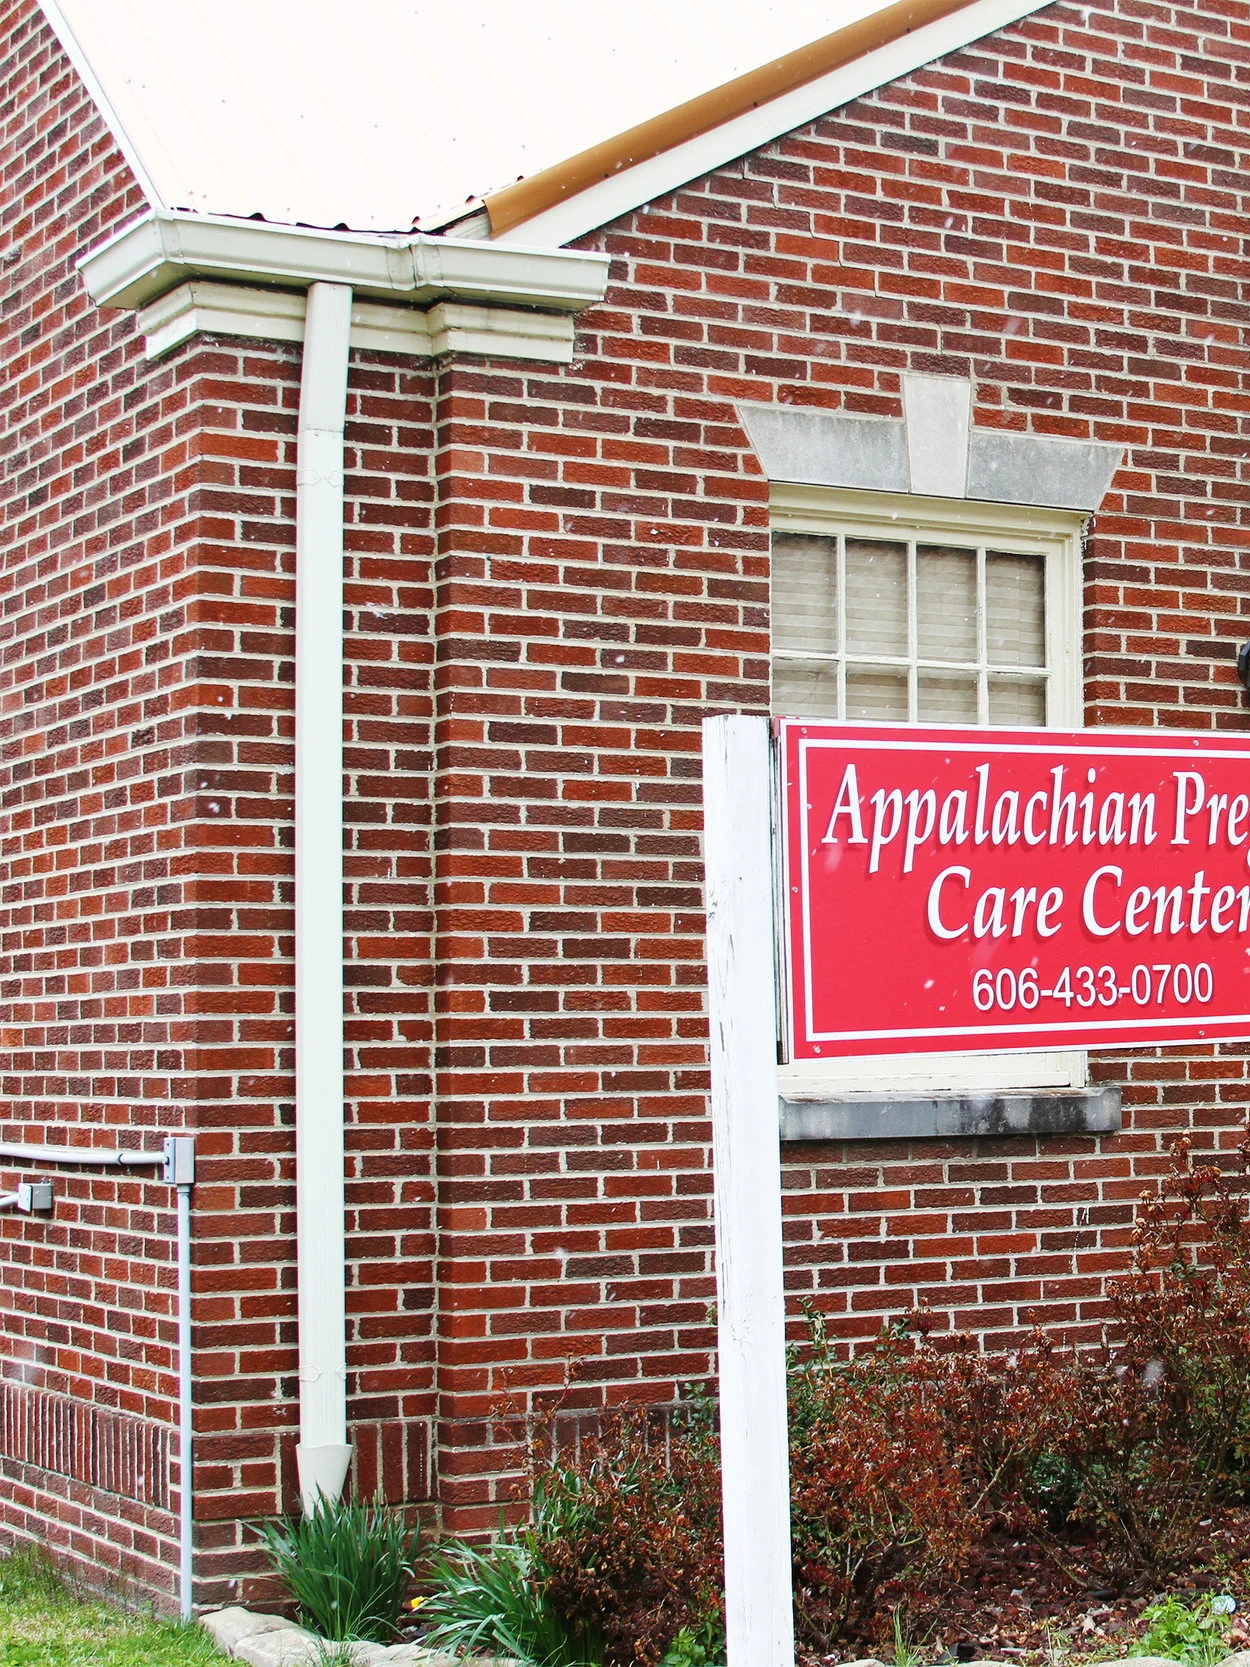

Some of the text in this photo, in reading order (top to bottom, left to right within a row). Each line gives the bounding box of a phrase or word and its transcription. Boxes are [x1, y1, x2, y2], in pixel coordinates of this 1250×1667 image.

[821, 763, 1157, 873] Appalachian
[927, 865, 1063, 939] Care
[972, 962, 1213, 1011] 606-433-0700
